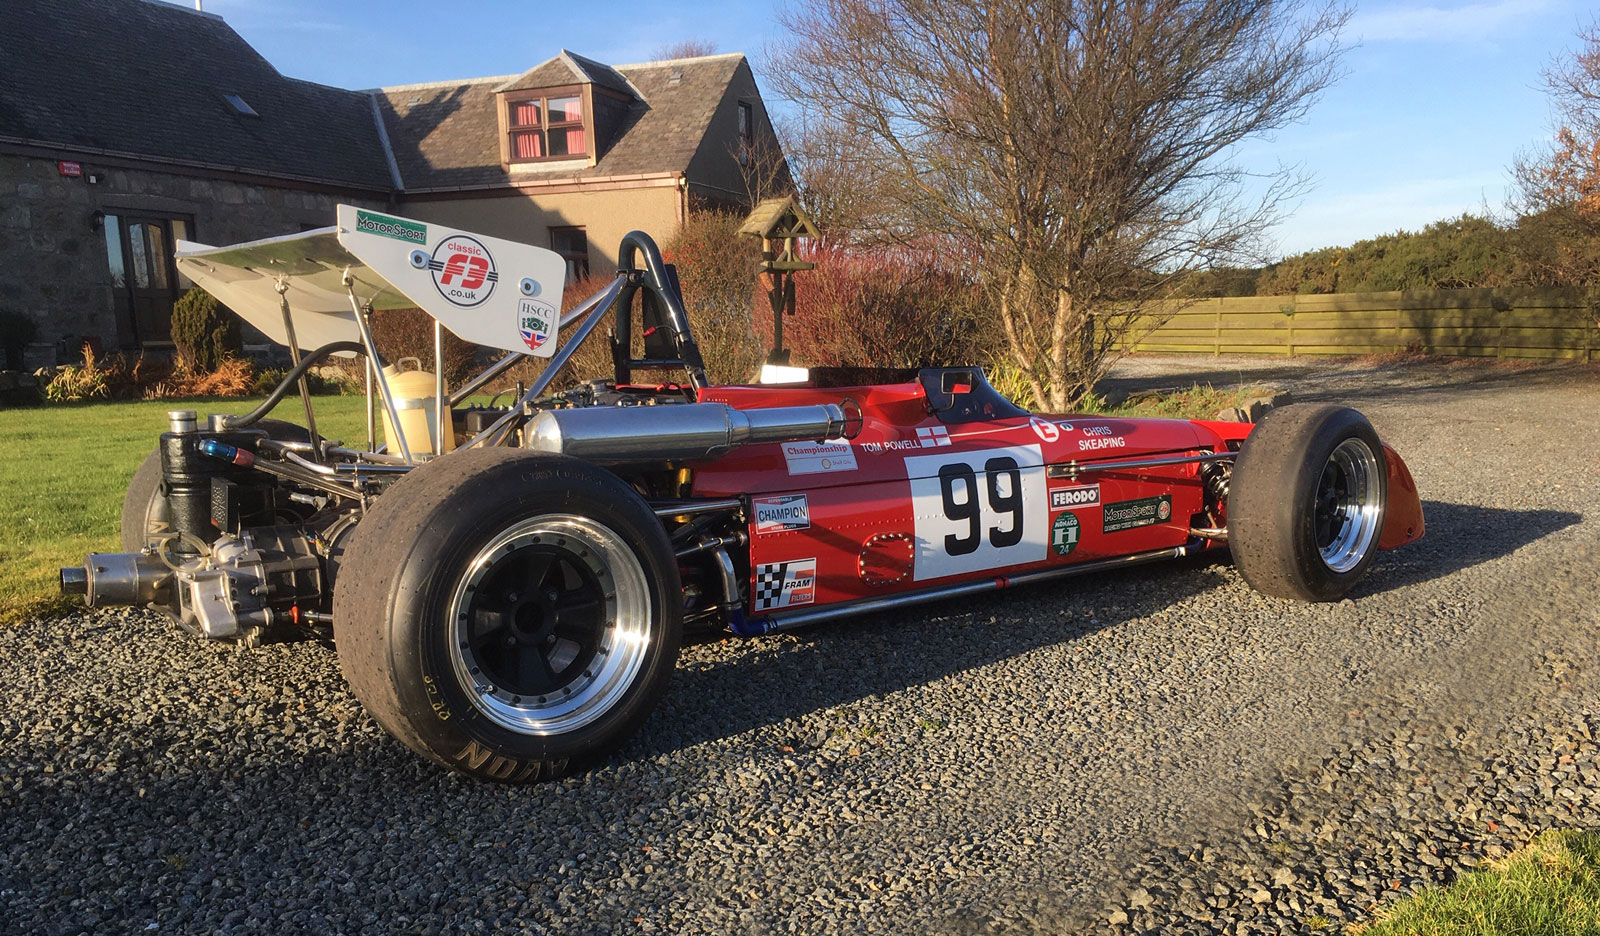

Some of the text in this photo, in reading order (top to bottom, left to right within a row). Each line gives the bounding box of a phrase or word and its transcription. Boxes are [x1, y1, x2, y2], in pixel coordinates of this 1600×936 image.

[447, 242, 482, 255] classic
[440, 254, 489, 290] F3
[448, 289, 476, 300] .co.uk
[522, 303, 552, 319] HSCC
[1083, 426, 1112, 437] CHRIS
[787, 444, 848, 455] Championship
[860, 440, 921, 452] TOM POWELL
[1078, 437, 1125, 451] SKEAPING
[1053, 489, 1097, 505] FERODO
[938, 456, 1023, 556] 99
[758, 506, 806, 522] CHAMPION
[1052, 526, 1079, 546] H
[1059, 544, 1069, 554] 24
[785, 579, 811, 589] FRAM
[455, 740, 569, 782] AVON
